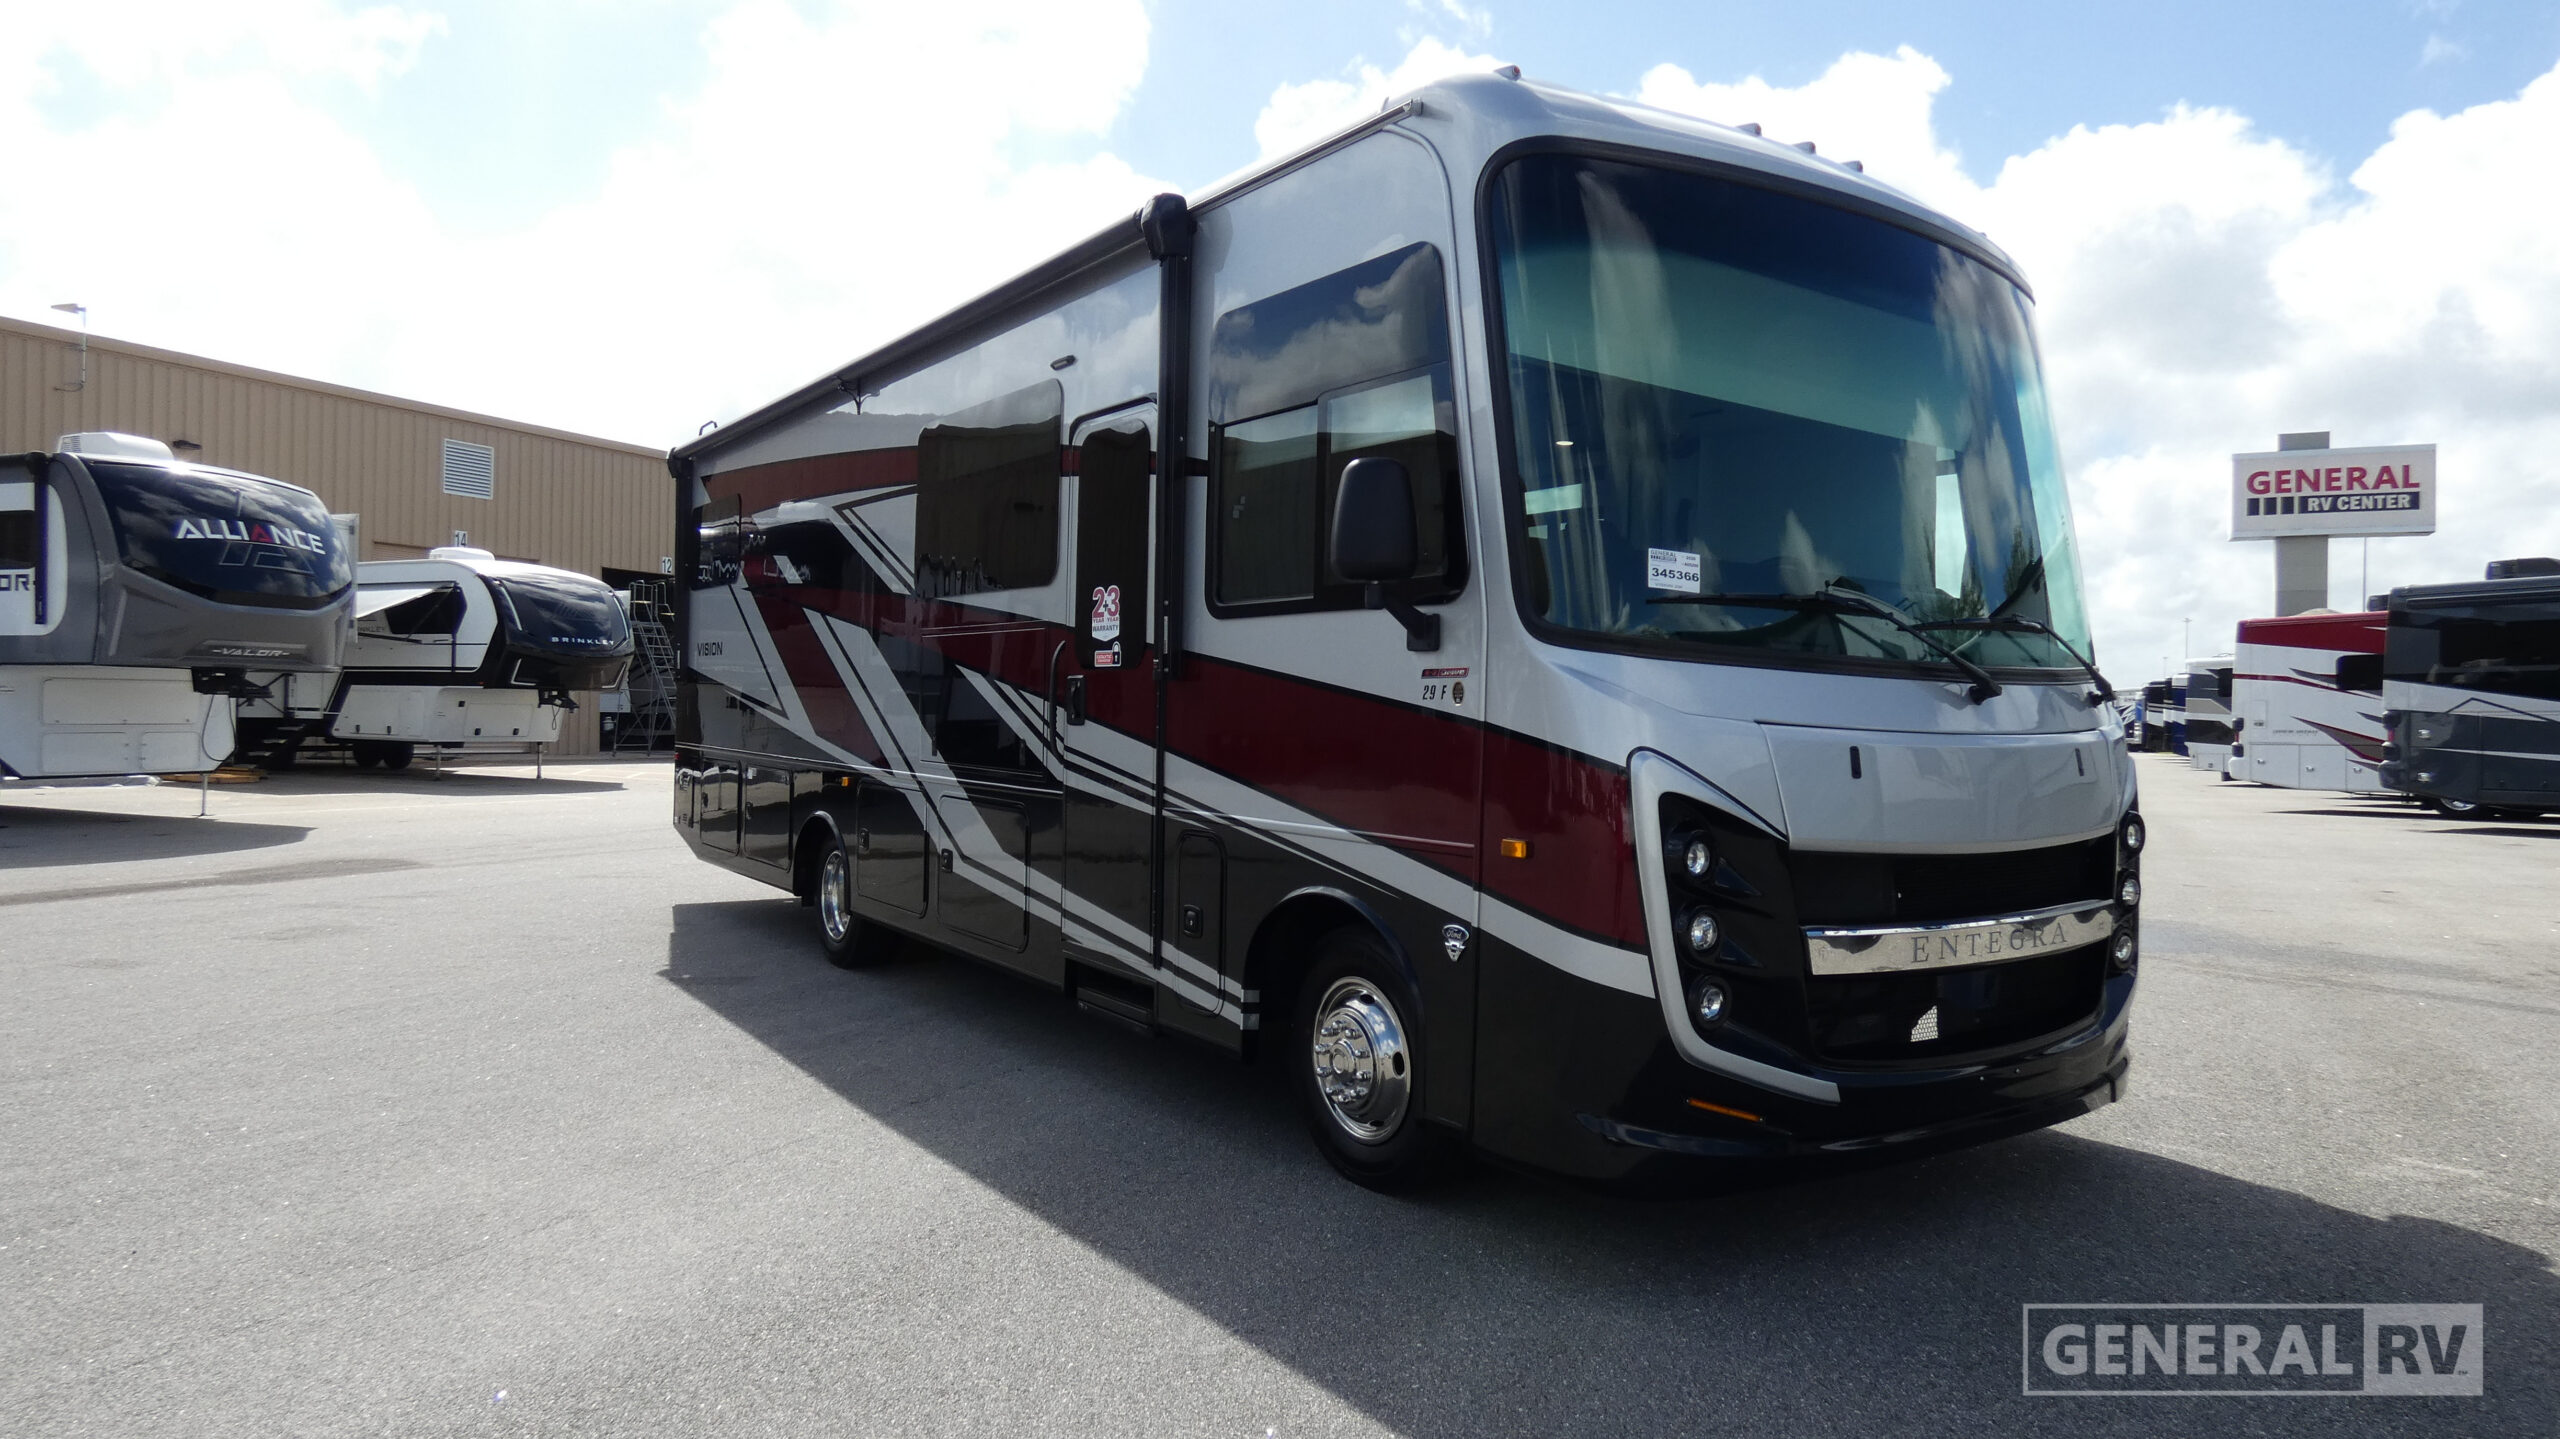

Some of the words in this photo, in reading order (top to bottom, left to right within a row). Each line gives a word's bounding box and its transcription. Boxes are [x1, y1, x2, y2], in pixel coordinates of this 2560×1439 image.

[2246, 465, 2420, 494] GENERAL
[2307, 497, 2333, 512] RV
[2337, 495, 2410, 511] CENTER
[176, 519, 326, 555] ALLIANCE
[455, 531, 466, 547] 14
[661, 558, 672, 573] 12
[1652, 567, 1700, 582] 345366
[1093, 624, 1119, 632] WARRANTY
[551, 636, 614, 645] BRINKLEY
[220, 648, 283, 657] VALOR
[697, 641, 723, 656] VISION
[1422, 684, 1437, 700] 29
[1440, 684, 1448, 700] F
[1446, 928, 1463, 939] Ford
[1911, 922, 2067, 963] ENTEGRA
